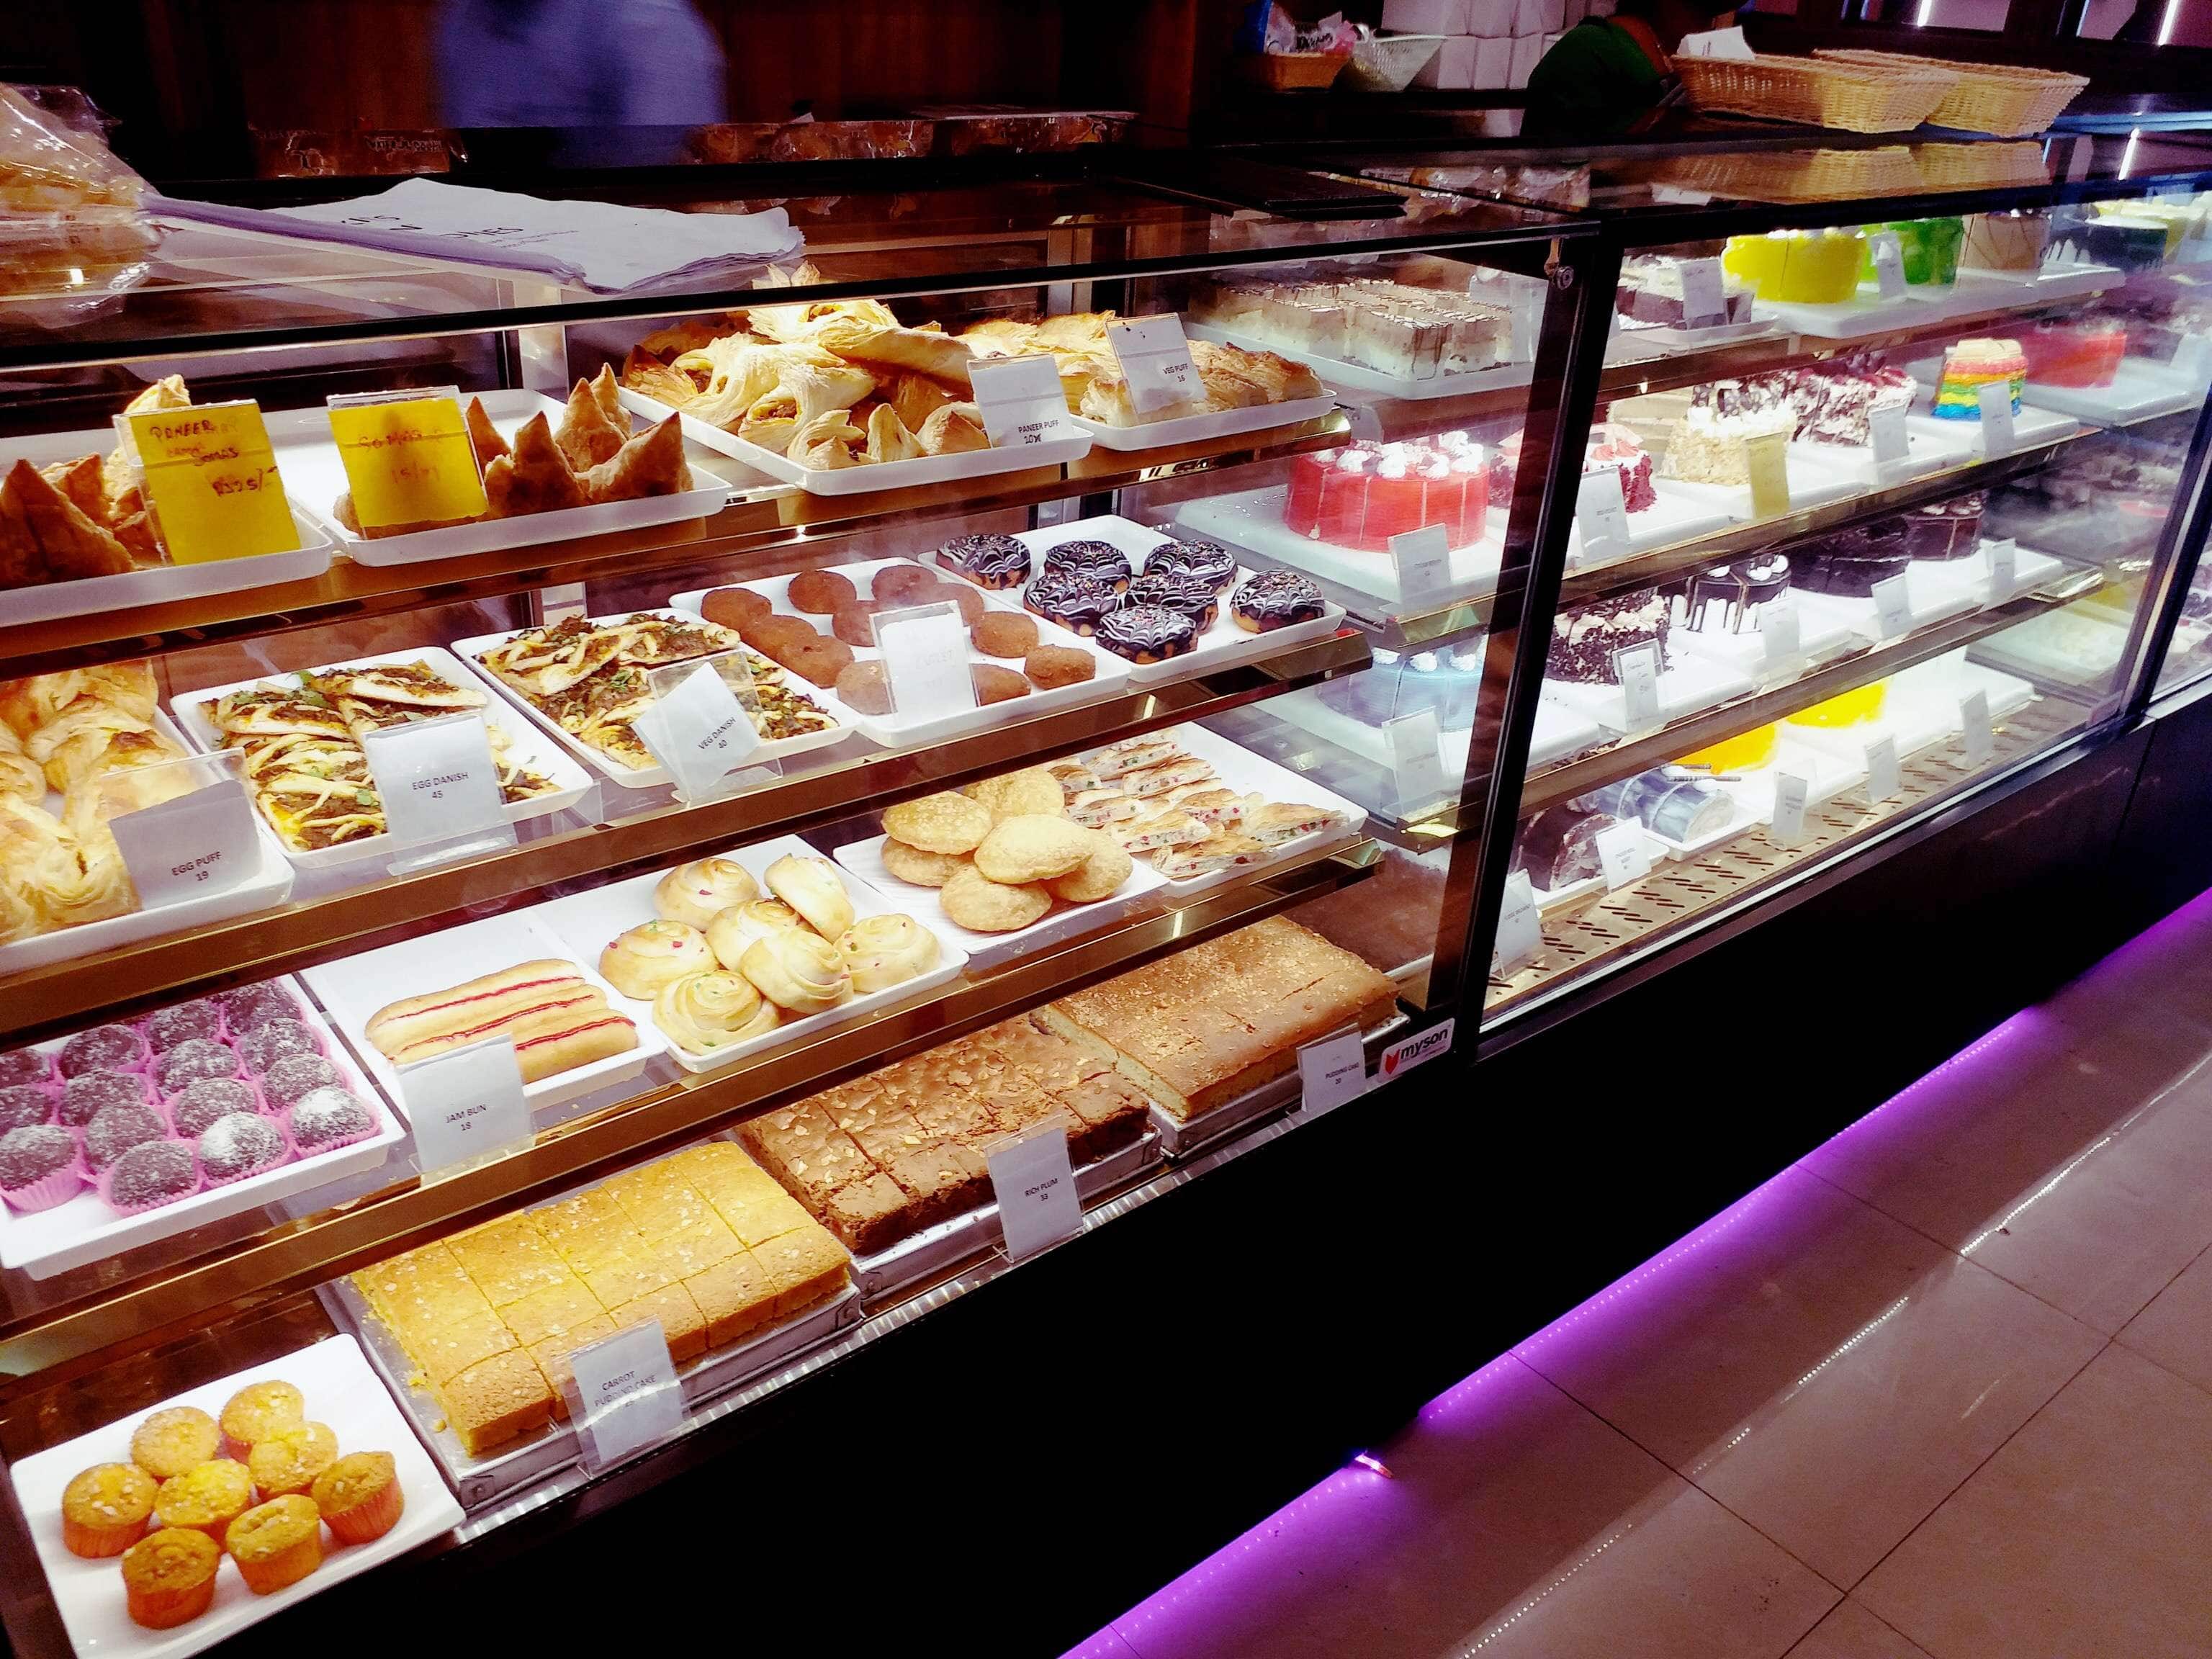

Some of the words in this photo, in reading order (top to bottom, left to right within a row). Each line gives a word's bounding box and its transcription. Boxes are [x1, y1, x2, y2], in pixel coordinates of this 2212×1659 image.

[1163, 366, 1175, 374] VEG
[1018, 423, 1043, 433] PANEER
[1044, 419, 1059, 429] PUFF
[698, 736, 714, 750] VEG
[712, 716, 737, 739] DANISH
[412, 780, 431, 791] EGG
[433, 771, 469, 786] DANISH
[171, 862, 194, 876] EGG
[195, 850, 222, 866] PUFF
[195, 871, 209, 881] 19
[1401, 1028, 1449, 1060] myson
[446, 1111, 465, 1124] JAM
[467, 1104, 487, 1117] BUN
[1025, 1187, 1039, 1197] RICH
[1040, 1178, 1058, 1190] PLUM
[602, 1370, 635, 1391] CARROT
[634, 1375, 657, 1390] CAKE
